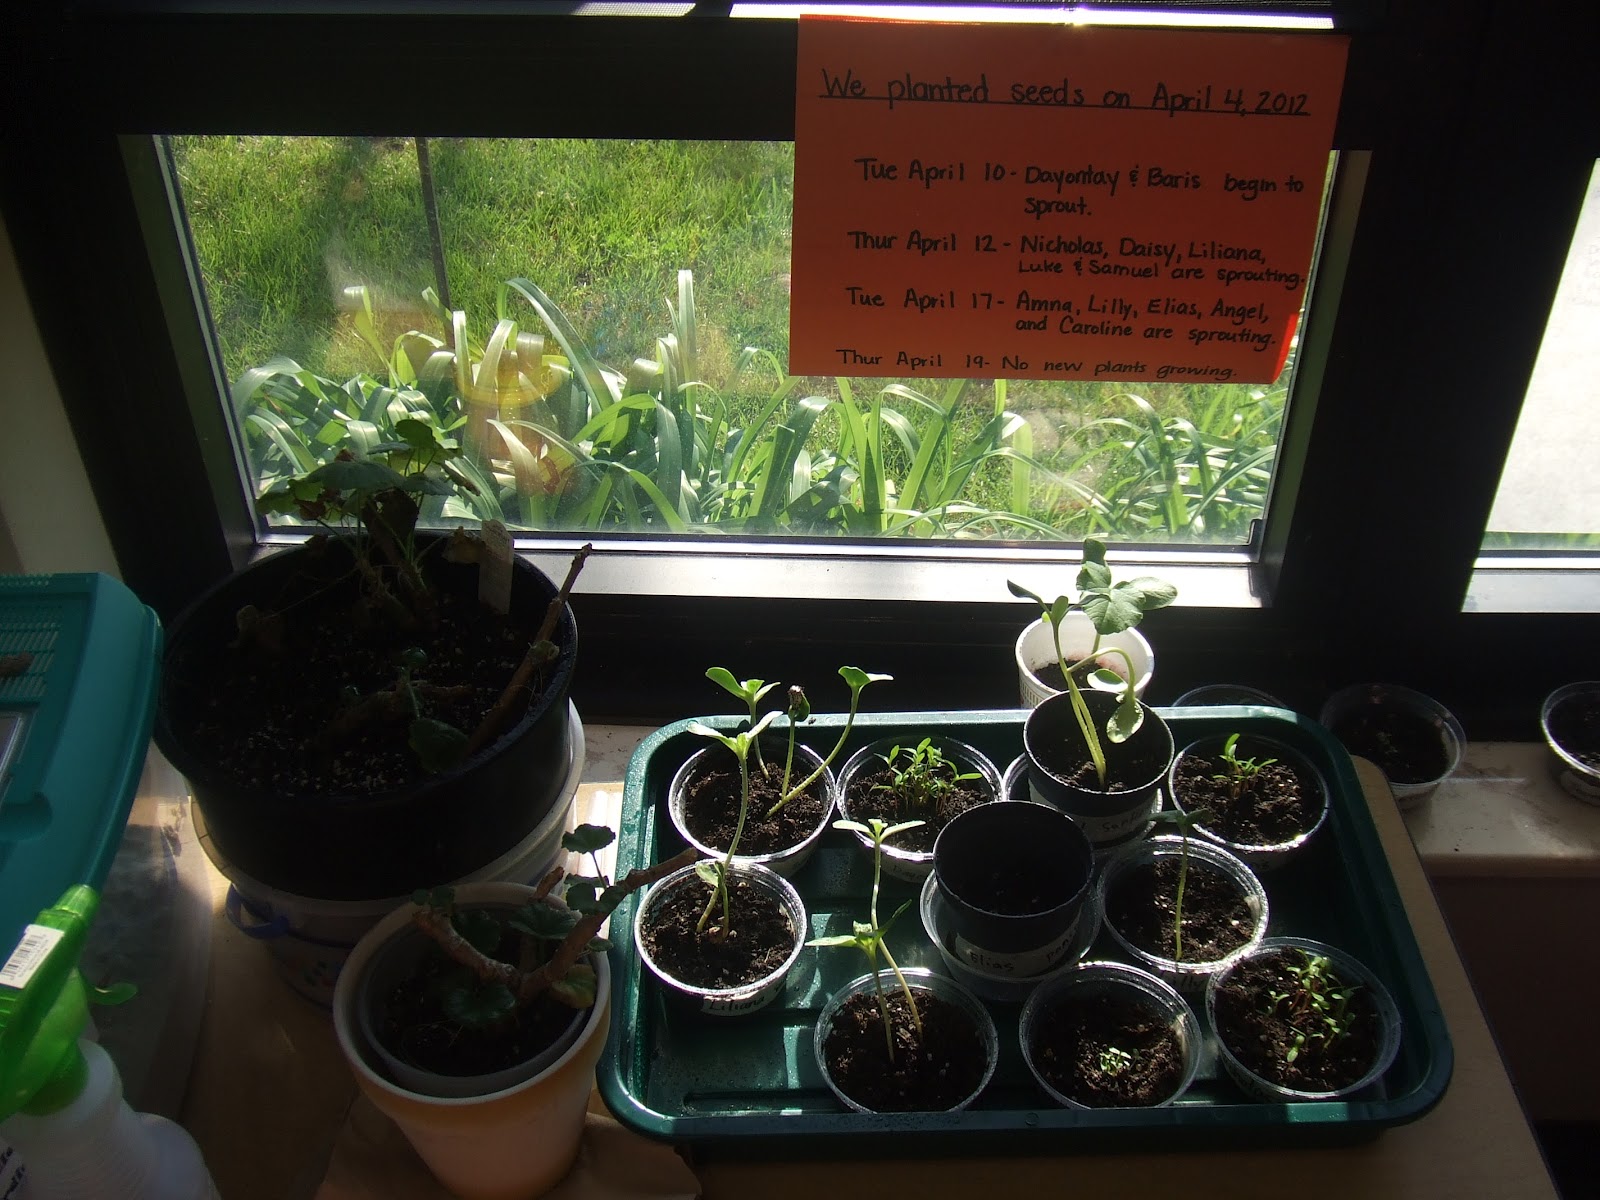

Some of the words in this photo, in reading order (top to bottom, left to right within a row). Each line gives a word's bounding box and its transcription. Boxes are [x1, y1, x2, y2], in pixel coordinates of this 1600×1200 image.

[821, 68, 866, 97] We
[886, 73, 989, 110] planted
[1010, 78, 1086, 107] seeds
[1102, 89, 1131, 109] on
[1150, 82, 1211, 118] April
[1256, 90, 1311, 116] 2012
[853, 157, 898, 182] Tue
[907, 158, 965, 190] April
[1024, 163, 1121, 198] Dayontay
[1147, 166, 1202, 190] Baris
[1223, 172, 1278, 202] begin
[1284, 174, 1305, 193] to
[846, 230, 899, 250] Thur
[906, 228, 957, 257] April
[1020, 234, 1109, 260] Nicholas,
[1118, 236, 1182, 268] Daisy,
[1187, 240, 1266, 270] Liliana,
[1017, 259, 1064, 274] Luke
[1088, 259, 1160, 279] Samuel
[1170, 267, 1206, 280] are
[1216, 267, 1306, 292] sprouting.
[845, 286, 886, 308] Tue
[903, 287, 955, 314] April
[1015, 289, 1081, 316] Amna,
[1087, 293, 1139, 321] Lilly,
[1146, 297, 1203, 320] Elias,
[1209, 297, 1270, 326] Angel,
[1015, 315, 1048, 332] and
[1058, 314, 1134, 337] Caroline
[1142, 326, 1174, 339] are
[1187, 328, 1277, 353] sprouting.
[835, 348, 883, 365] Thur
[896, 350, 942, 371] April
[1001, 354, 1029, 371] No
[1043, 361, 1084, 372] new
[1094, 360, 1148, 377] plants
[1156, 364, 1235, 383] growing.
[969, 950, 1015, 972] Elias
